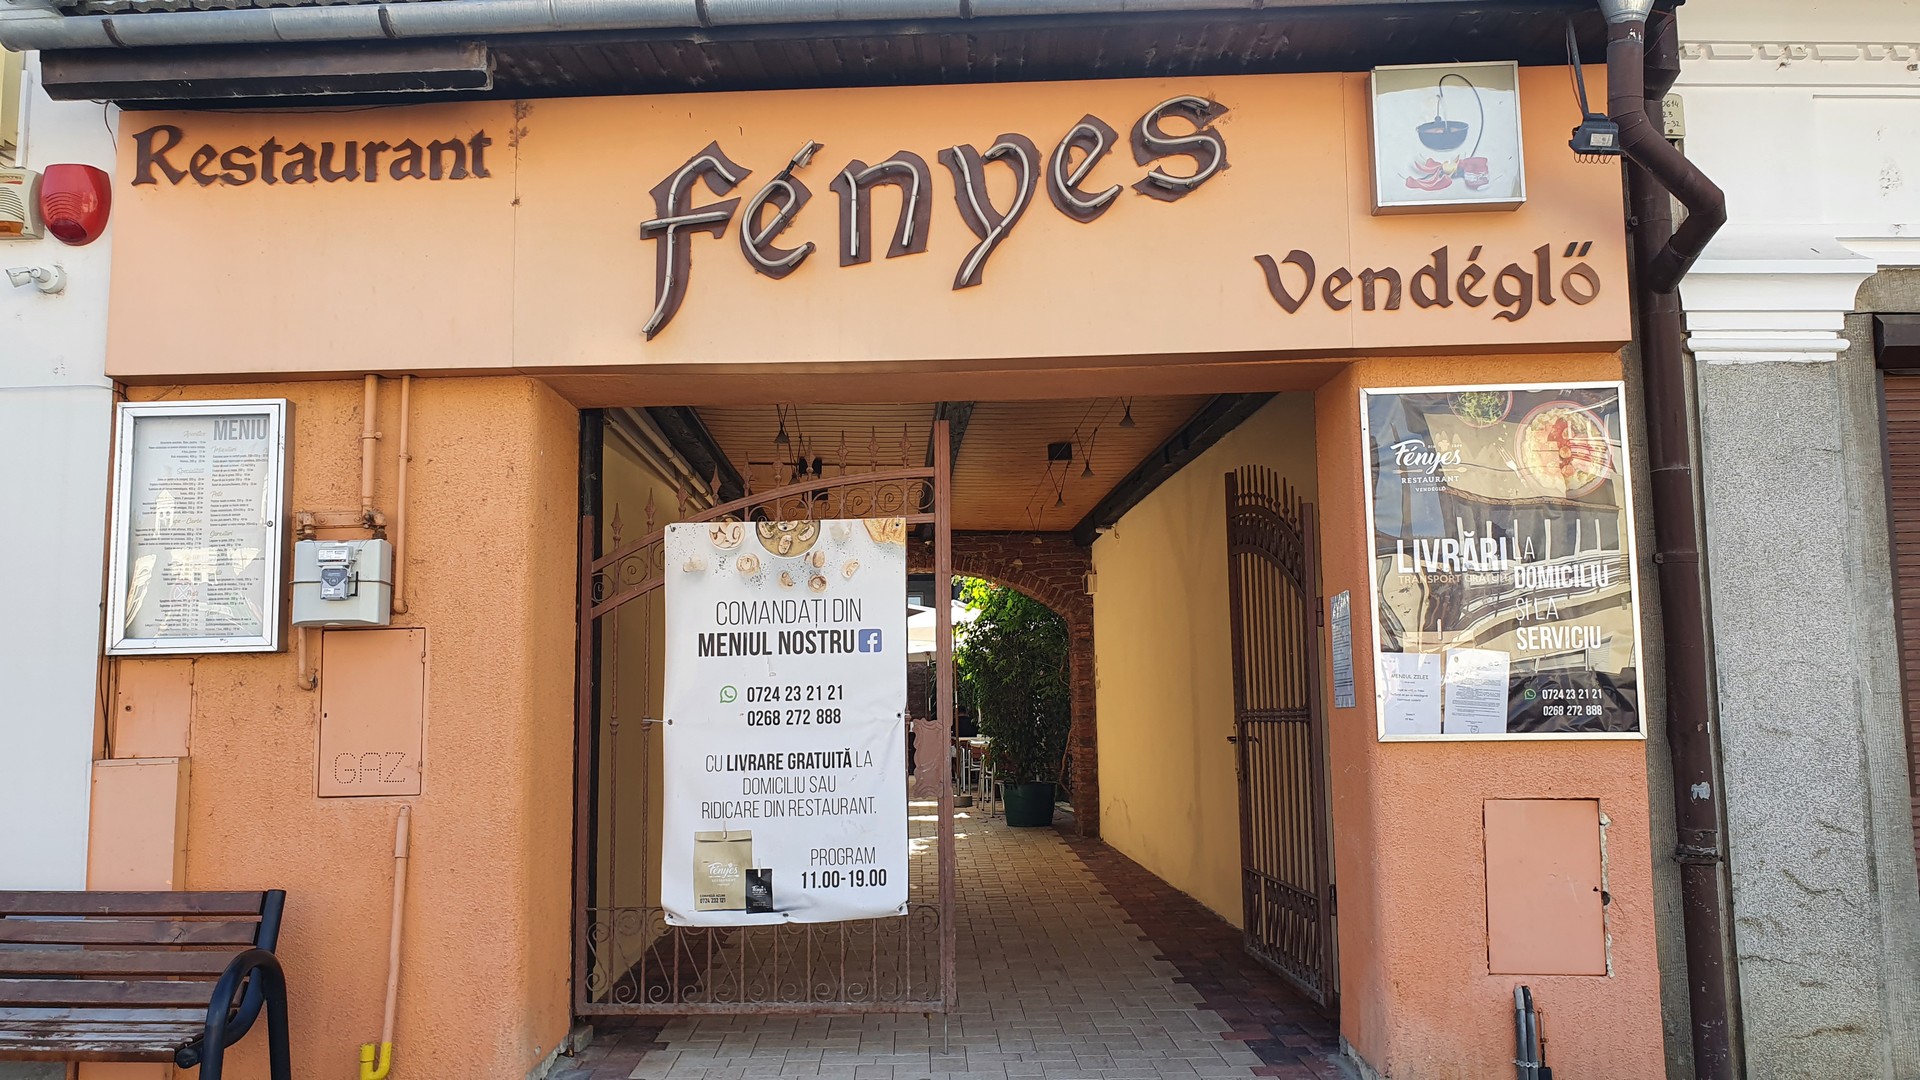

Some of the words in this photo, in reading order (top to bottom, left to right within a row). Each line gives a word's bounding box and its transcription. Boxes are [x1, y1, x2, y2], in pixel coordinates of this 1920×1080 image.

[131, 124, 492, 187] Restaurant
[1254, 241, 1601, 322] Vendéglő
[213, 419, 267, 441] MENIU
[1390, 439, 1462, 474] Fényes
[1401, 475, 1459, 484] RESTAURANT
[1396, 531, 1508, 574] LIVRĂRI
[1512, 536, 1536, 560] LA
[1398, 574, 1461, 585] TRANSPORT
[1514, 564, 1609, 590] DOMICILIU
[716, 598, 827, 628] COMANDAȚI
[832, 598, 862, 623] DIN
[1536, 597, 1559, 620] LA
[698, 631, 773, 657] MENIUL
[778, 629, 855, 655] NOSTRU
[1516, 625, 1602, 651] SERVICIU
[747, 686, 780, 703] 0724
[785, 686, 801, 701] 23
[806, 685, 822, 701] 21
[827, 684, 843, 700] 21
[1542, 689, 1564, 700] 0724
[1566, 689, 1576, 700] 23
[1578, 689, 1588, 699] 21
[1591, 688, 1602, 699] 21
[747, 710, 781, 727] 0268
[786, 709, 811, 725] 272
[816, 708, 841, 724] 888
[1543, 705, 1564, 716] 0268
[1567, 705, 1583, 716] 272
[1586, 705, 1603, 715] 888
[334, 751, 406, 784] GAZ
[706, 755, 723, 772] CU
[726, 752, 784, 771] LIVRARE
[787, 748, 852, 770] GRATUITĂ
[856, 750, 873, 767] LA
[743, 776, 806, 795] DOMICILIU
[809, 775, 836, 792] SAU
[702, 800, 760, 819] RIDICARE
[764, 800, 785, 817] DIN
[789, 797, 877, 817] RESTAURANT.
[811, 847, 876, 866] PROGRAM
[801, 869, 887, 889] 11.00-19.00
